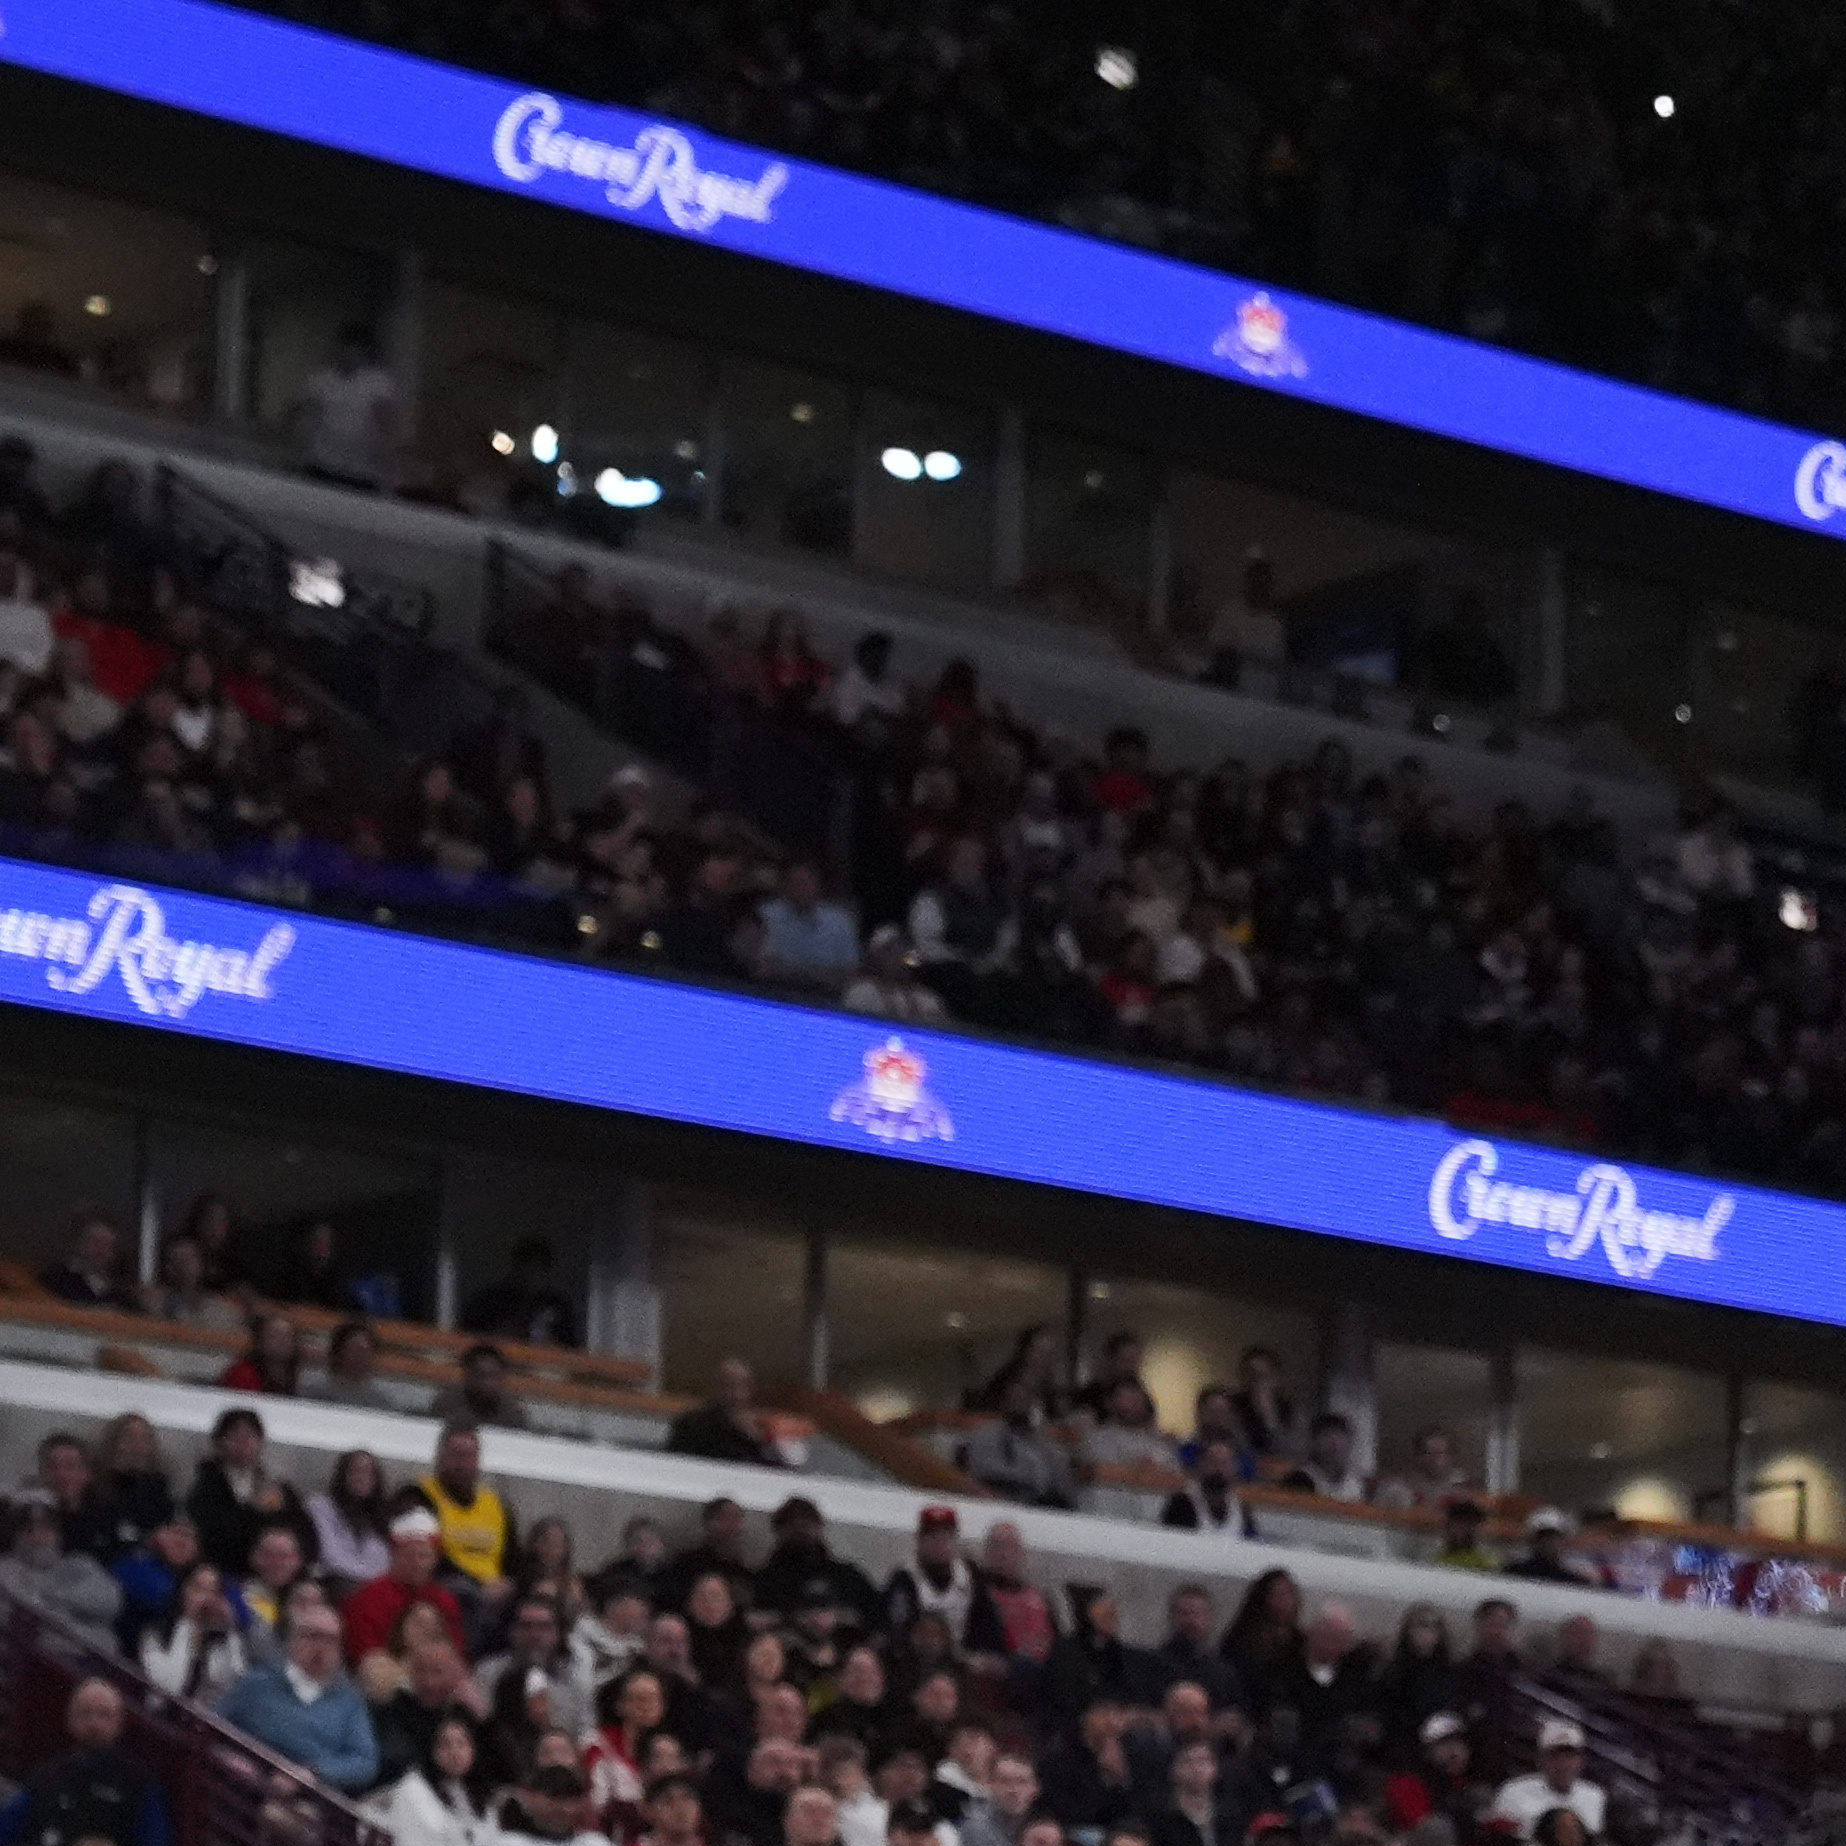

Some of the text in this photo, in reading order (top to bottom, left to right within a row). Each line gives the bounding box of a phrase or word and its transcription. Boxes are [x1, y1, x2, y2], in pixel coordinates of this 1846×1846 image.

[493, 92, 790, 231] Crown Royal
[46, 884, 297, 1018] Royal
[1429, 1139, 1736, 1278] Crown Royal
